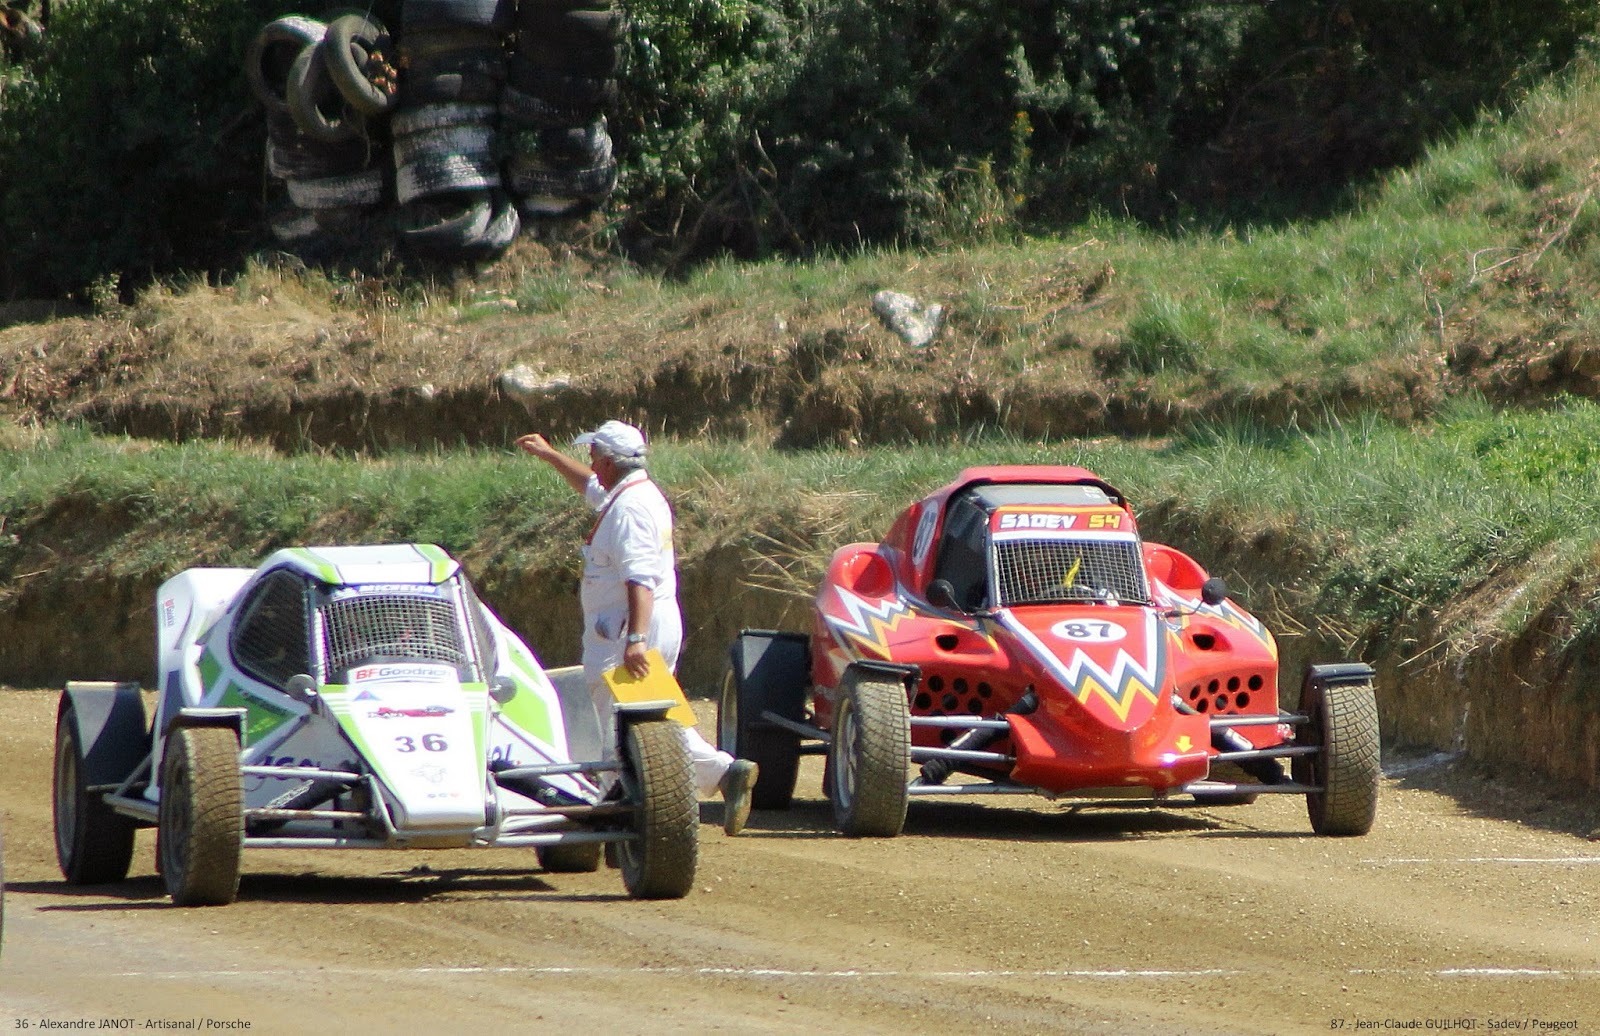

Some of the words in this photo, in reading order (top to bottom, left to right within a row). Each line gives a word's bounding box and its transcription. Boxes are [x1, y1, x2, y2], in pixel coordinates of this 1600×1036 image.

[1000, 514, 1077, 529] SADEV
[1064, 622, 1111, 639] 87
[394, 733, 449, 753] 36
